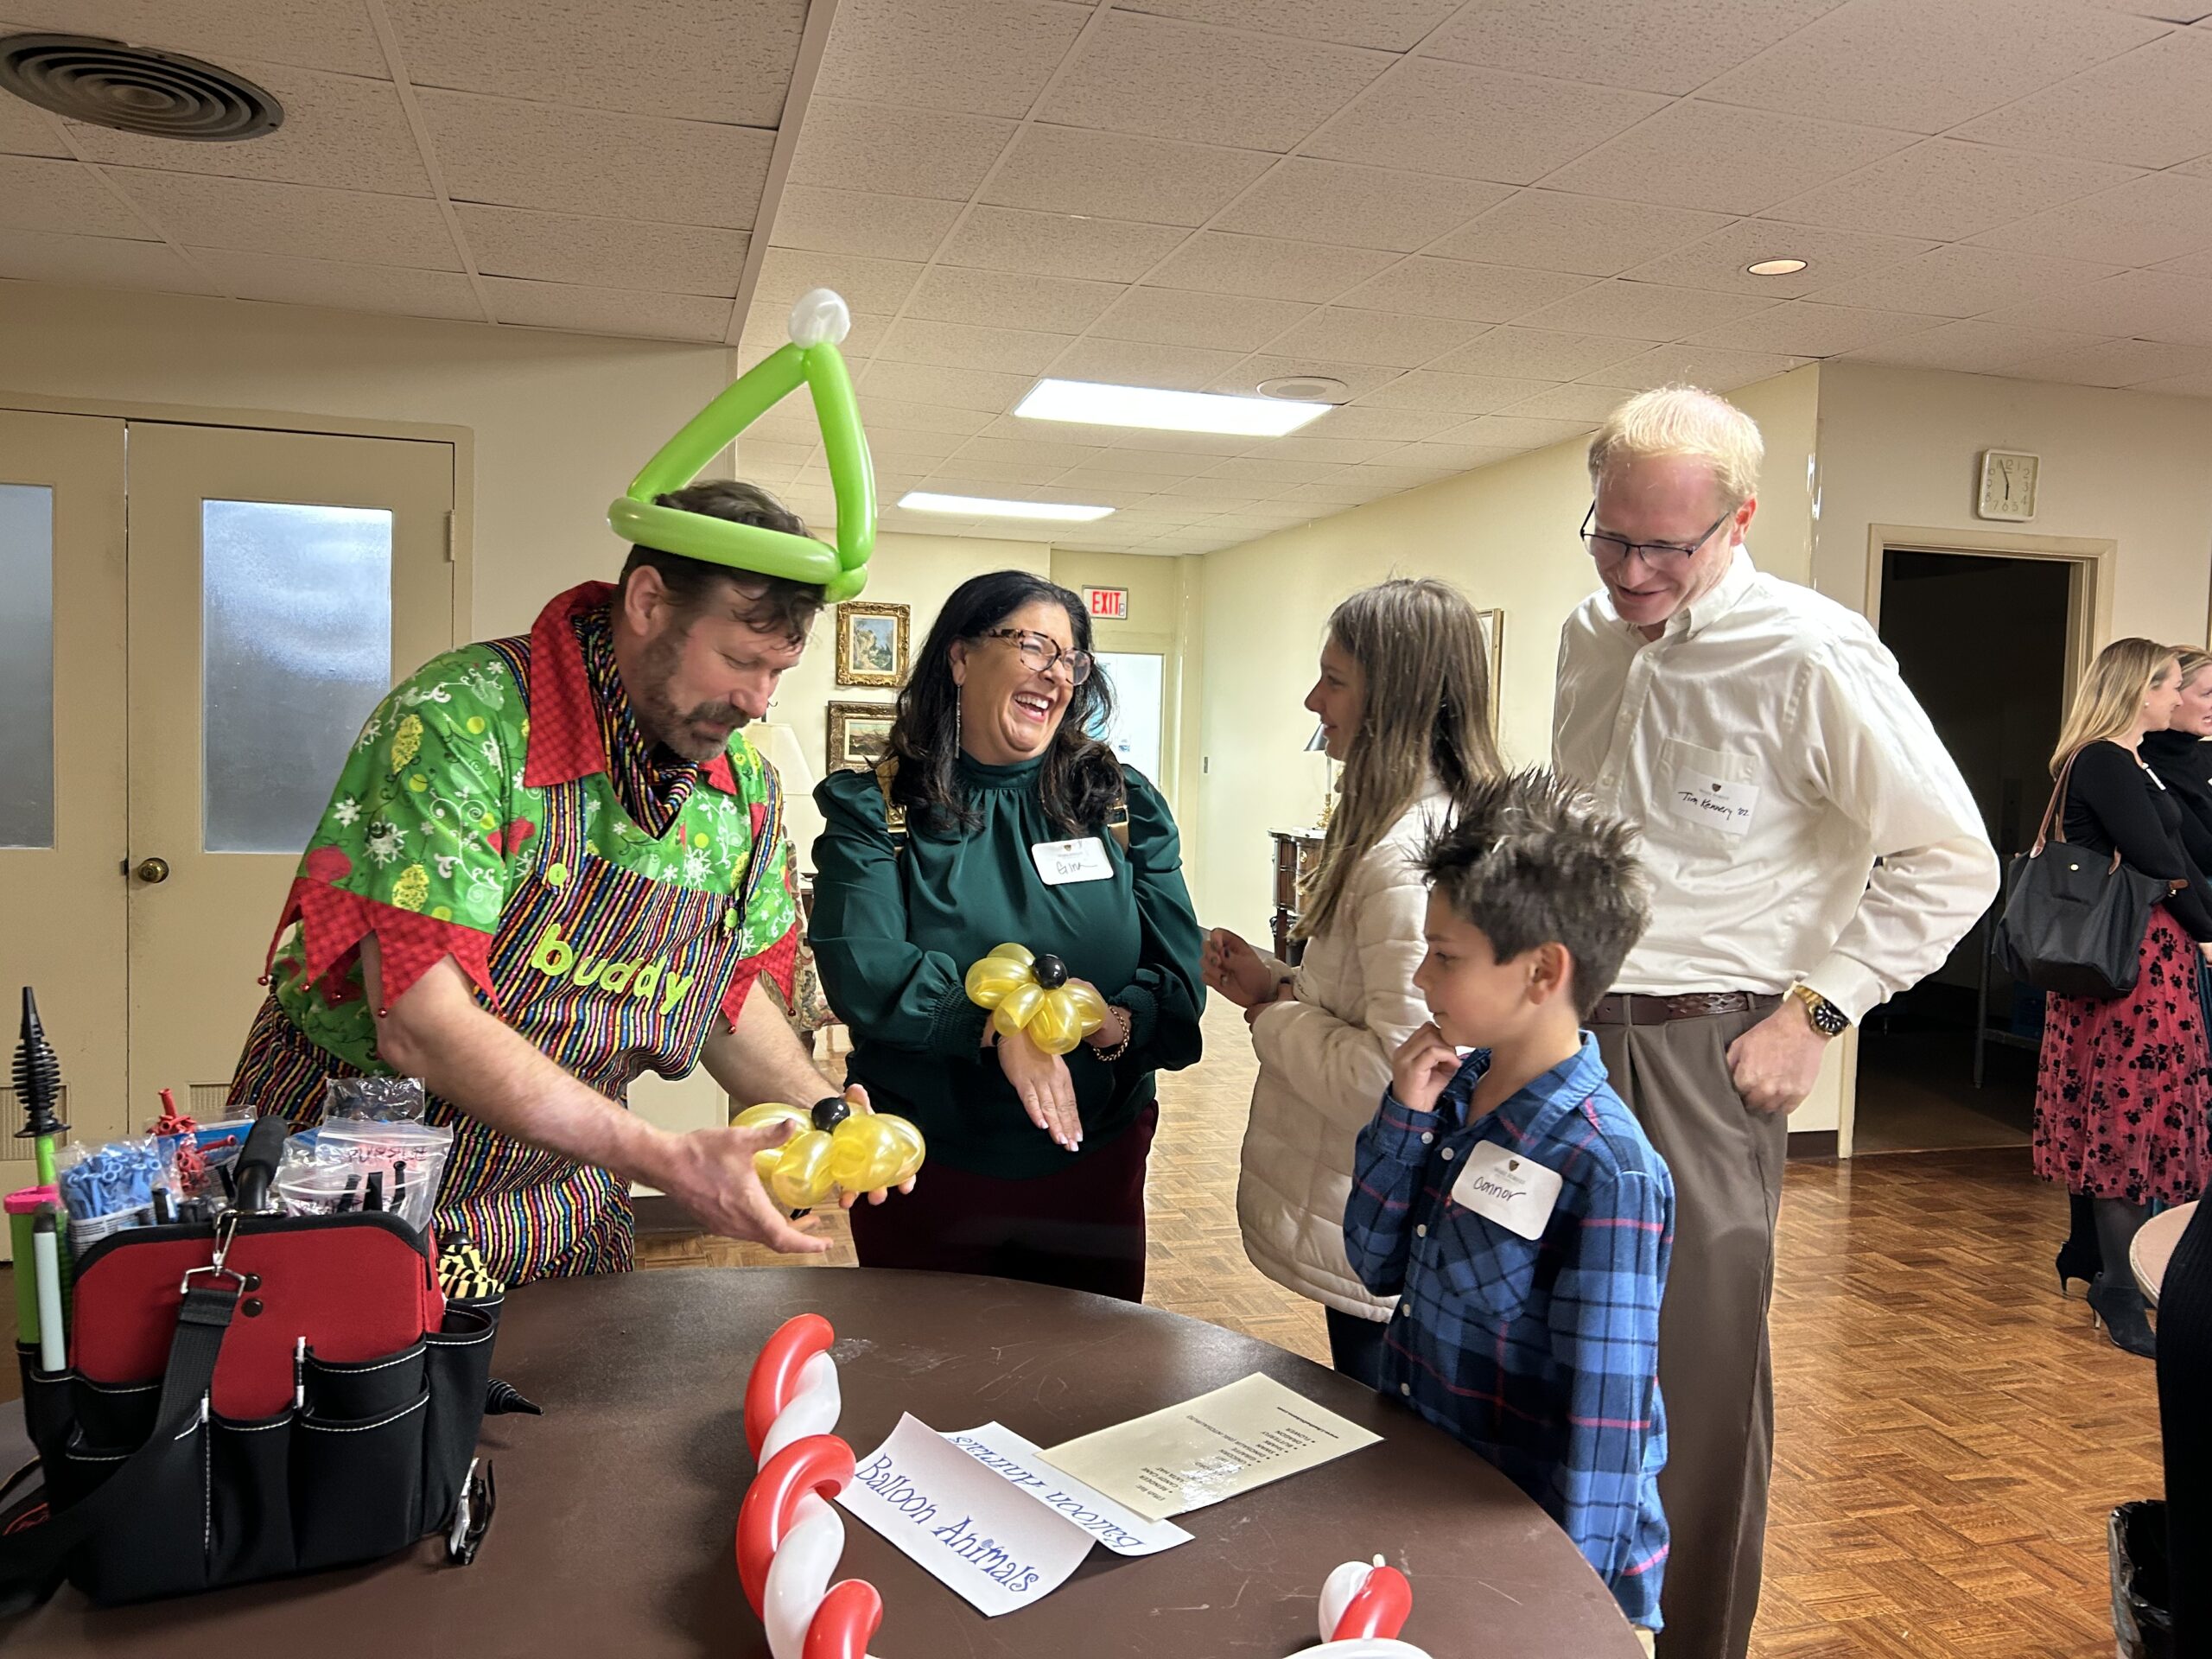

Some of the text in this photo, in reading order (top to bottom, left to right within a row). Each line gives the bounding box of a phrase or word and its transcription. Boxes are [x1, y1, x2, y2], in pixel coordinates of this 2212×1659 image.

[1092, 591, 1121, 614] EXIT
[1678, 791, 1698, 805] Tim
[531, 923, 694, 1015] buddy
[854, 1452, 1039, 1592] Balloon Animals
